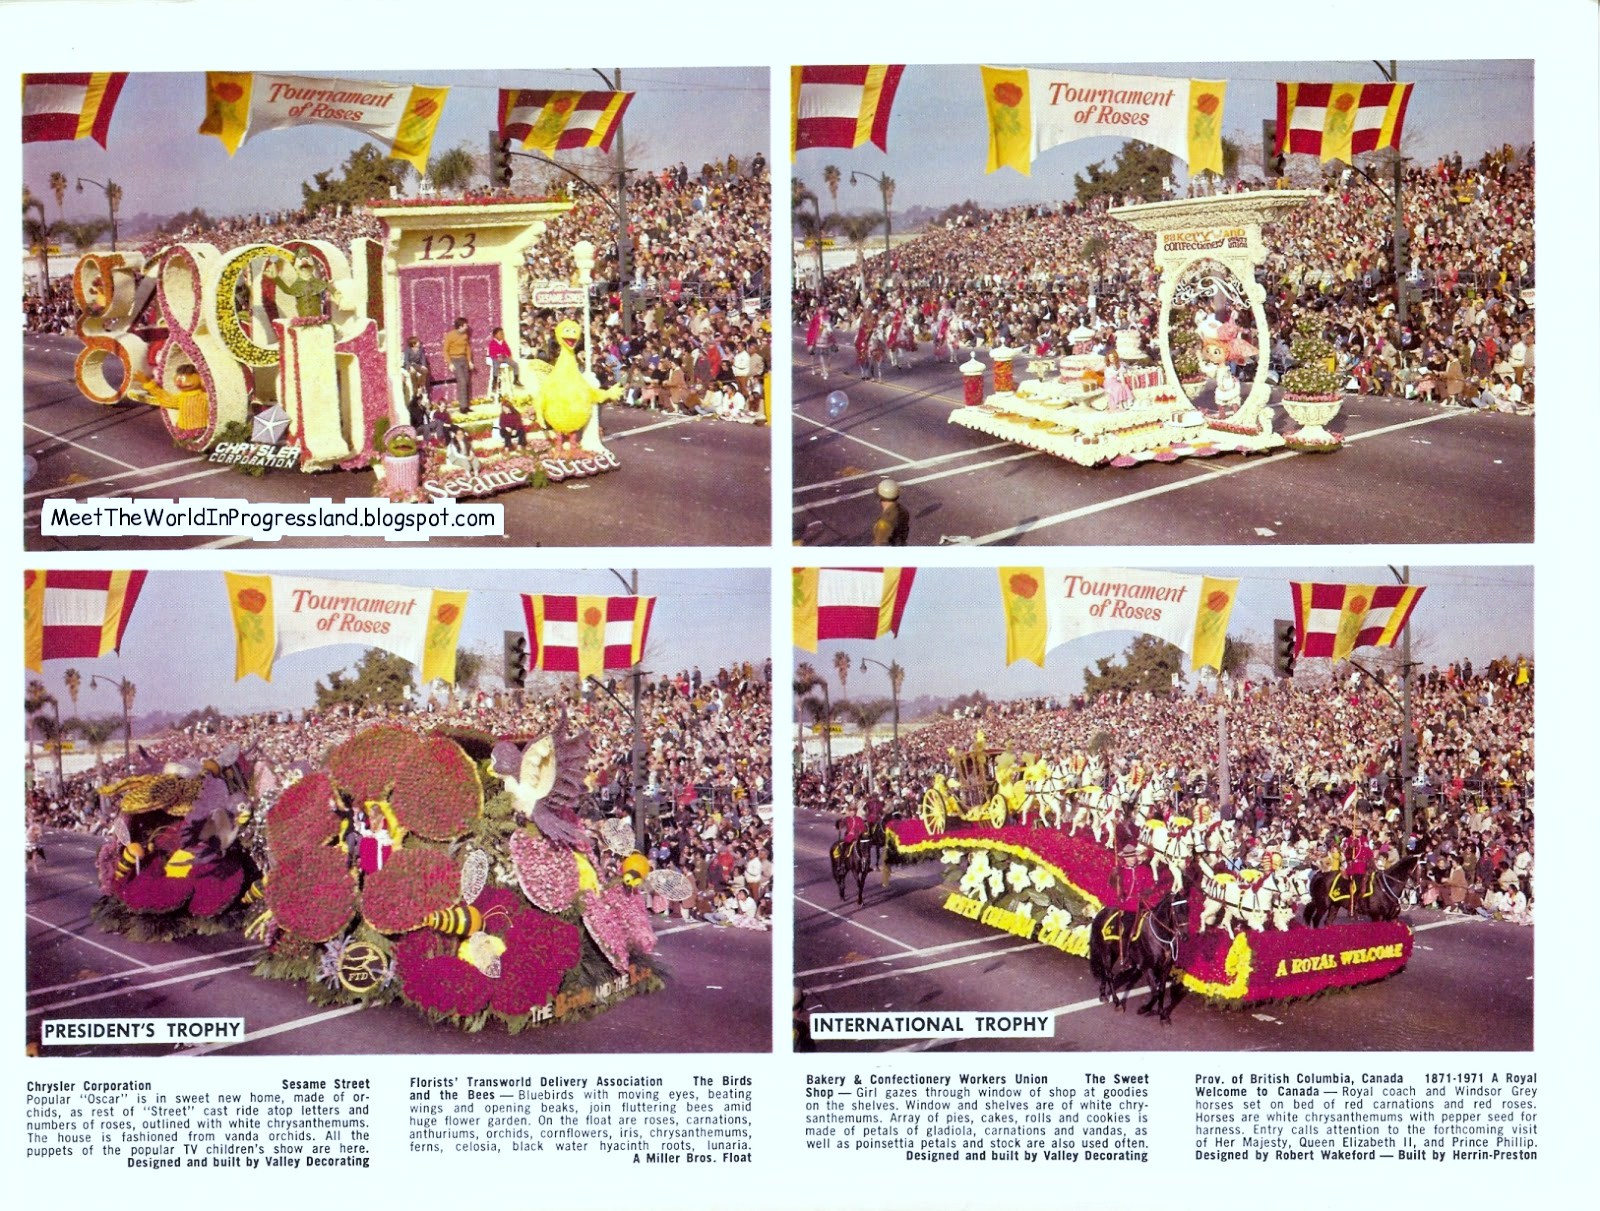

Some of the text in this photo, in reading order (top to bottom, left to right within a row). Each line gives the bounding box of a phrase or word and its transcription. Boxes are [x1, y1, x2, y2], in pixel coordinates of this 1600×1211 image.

[269, 83, 395, 108] Tournament
[1049, 82, 1175, 106] Tournament
[288, 102, 364, 121] of Roses
[1074, 105, 1149, 126] of Roses
[419, 233, 477, 261] 123
[215, 442, 301, 459] CHRYSLER
[209, 453, 295, 469] CORPORATION
[423, 449, 620, 500] Sesame Street
[1064, 575, 1187, 602] Tournament
[292, 589, 417, 616] Tournament
[1089, 599, 1162, 621] of Roses
[316, 613, 391, 634] of Roses
[1275, 942, 1403, 977] A ROYAL WELCOME
[282, 1079, 370, 1089] Sesame Street
[467, 1077, 531, 1087] Transworld
[541, 1077, 587, 1088] Delivery
[597, 1076, 662, 1086] Association
[693, 1076, 752, 1086] The Birds
[807, 1074, 1047, 1086] Bakery & Confectionery Workers Union
[1085, 1073, 1149, 1084] The Sweet
[1196, 1073, 1403, 1085] Prov. of British Columbia, Canada
[1425, 1073, 1536, 1085] 1871-1971 A Royal
[27, 1081, 151, 1093] Chrysler Corporation
[806, 1087, 1148, 1099] Shop Girl gazes through window of shop at goodies
[1196, 1086, 1537, 1098] Welcome to Canada Royal coach and Windsor Grey
[410, 1089, 751, 1101] and the Bees Bluebirds with moving eyes, beating
[806, 1112, 1147, 1124] santhemums. Array of pies, cakes, rolls and cookies is
[27, 1118, 368, 1131] numbers of roses, outlined with white chrysanthemums.
[1196, 1124, 1537, 1136] harness. Entry calls attention to the forthcoming visit
[28, 1133, 47, 1142] The
[58, 1133, 91, 1142] house
[122, 1131, 177, 1142] fashioned
[189, 1131, 214, 1141] from
[225, 1131, 258, 1141] vanda
[269, 1131, 315, 1141] orchids.
[326, 1131, 340, 1140] All
[351, 1130, 369, 1140] the
[410, 1128, 751, 1140] anthuriums, orchids, cornflowers, iris, chrysanthemums,
[633, 1153, 751, 1163] A Miller Bros. Float
[907, 1150, 1148, 1162] Designed and built by Valley Decorating
[1196, 1150, 1537, 1162] Designed by Robert Wakeford Built by Herrin-Preston
[128, 1156, 369, 1169] Designed and built by Valley Decorating
